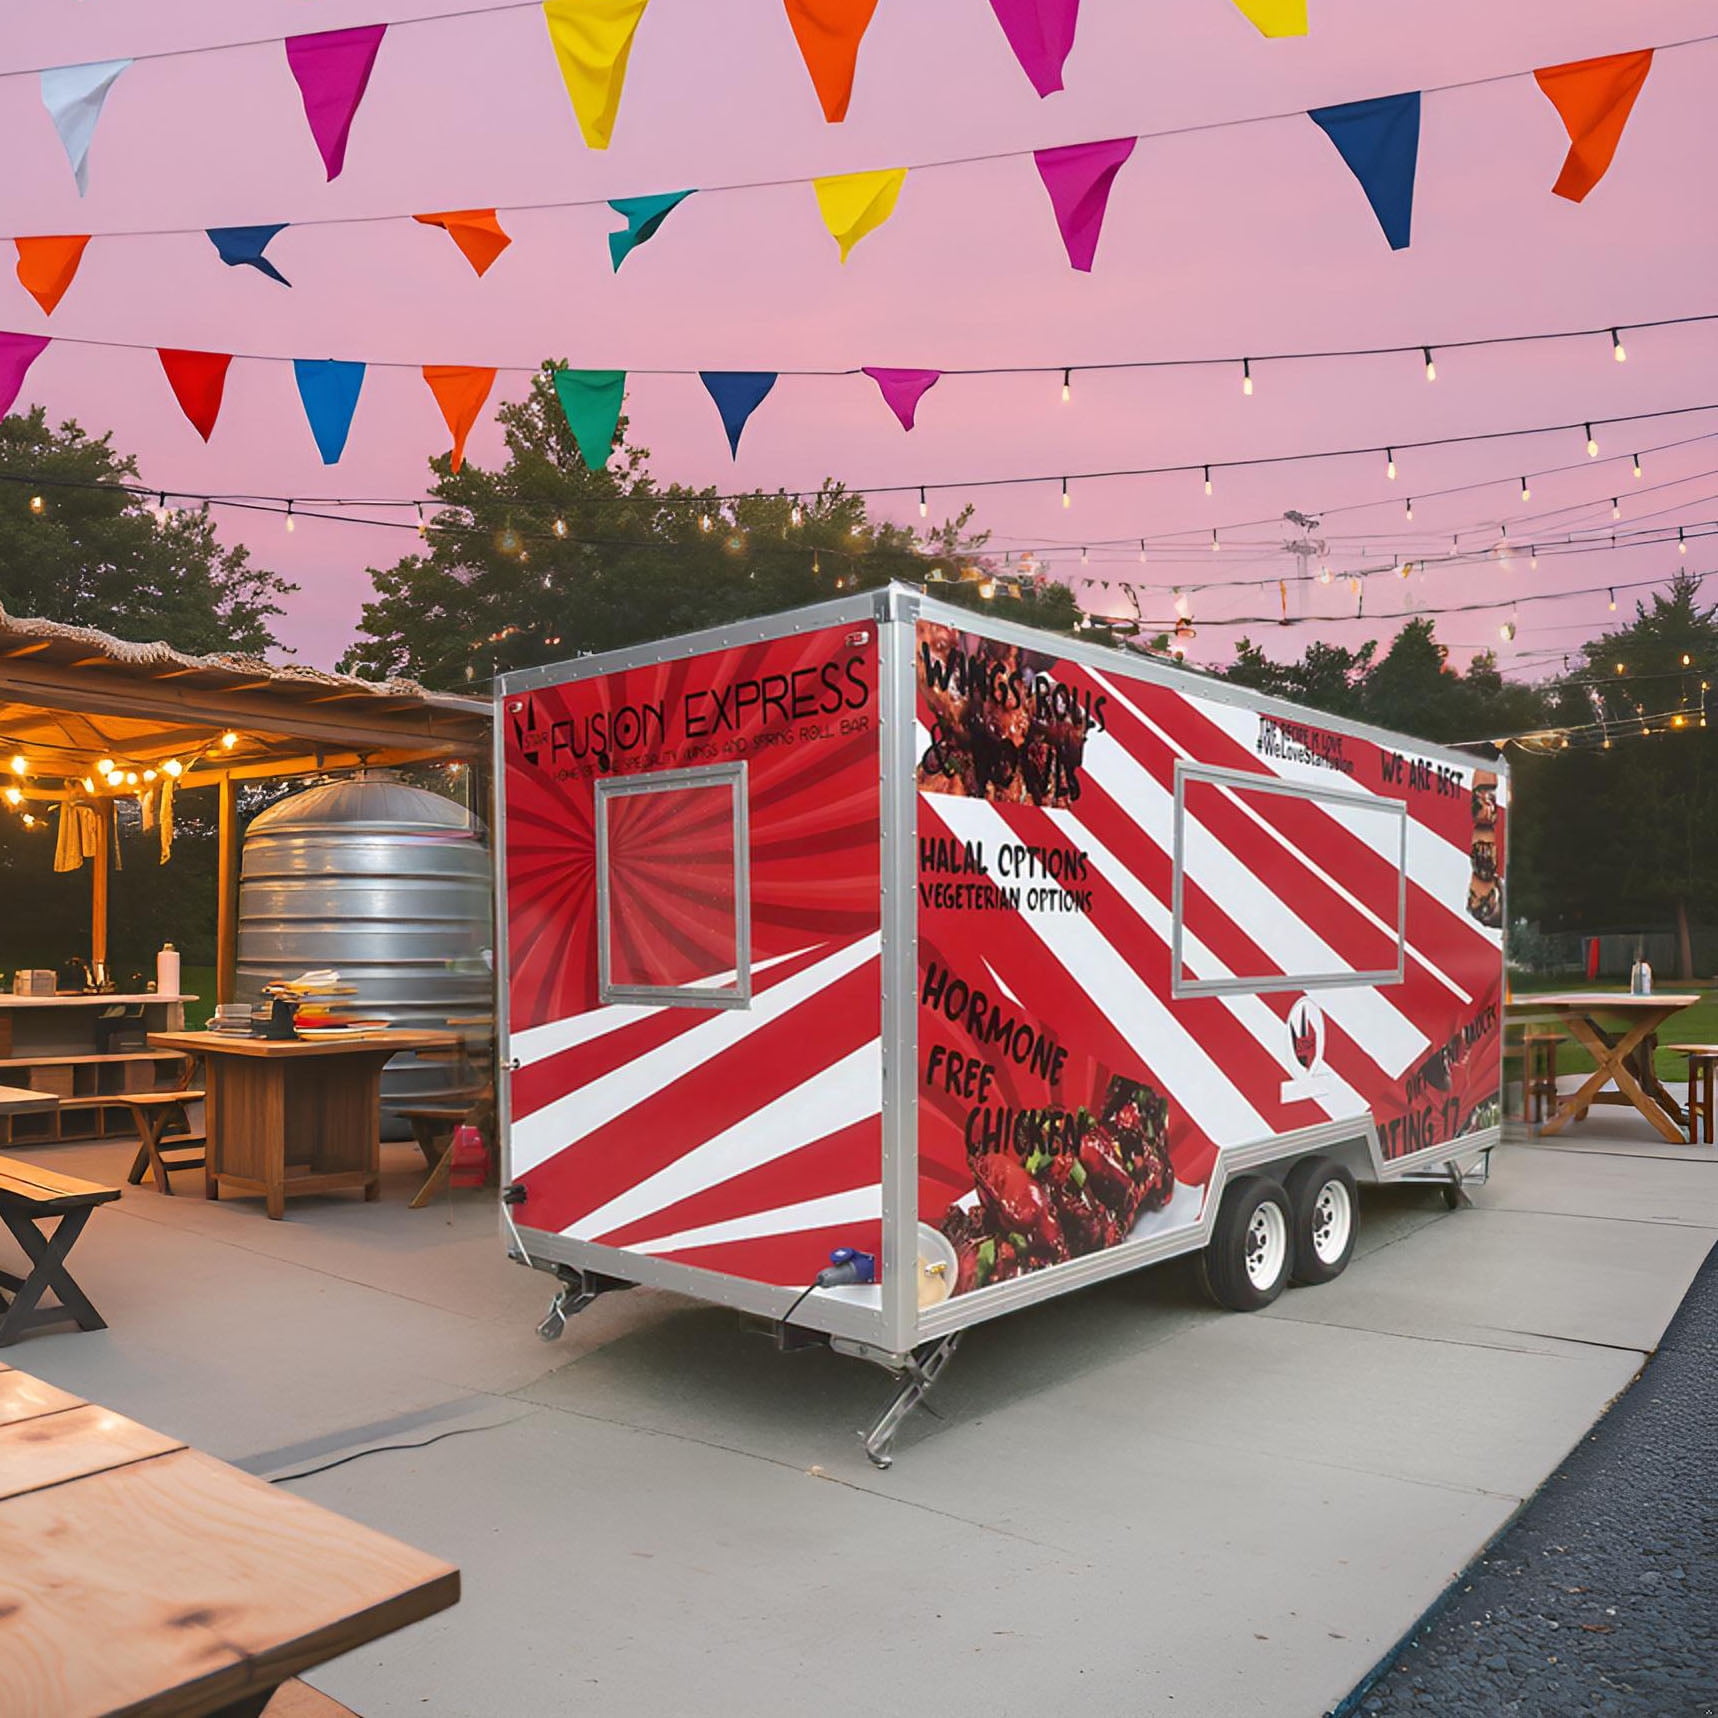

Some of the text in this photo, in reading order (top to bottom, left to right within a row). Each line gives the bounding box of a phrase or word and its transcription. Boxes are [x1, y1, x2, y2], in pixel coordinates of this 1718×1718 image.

[551, 656, 869, 765] FUSION EXPRESS
[800, 725, 834, 741] ROLL
[840, 716, 869, 736] BAR
[1035, 675, 1107, 732] ROLLS
[1381, 750, 1464, 798] WE ARE BEST
[919, 837, 1088, 881] HALAL OPTIONS
[919, 882, 1093, 913] VEGETERIAN OPTIONS
[922, 962, 1068, 1086] HORMONE
[927, 1045, 995, 1105] FREE
[965, 1106, 1082, 1157] CHICKEN
[1376, 1105, 1434, 1160] ATING
